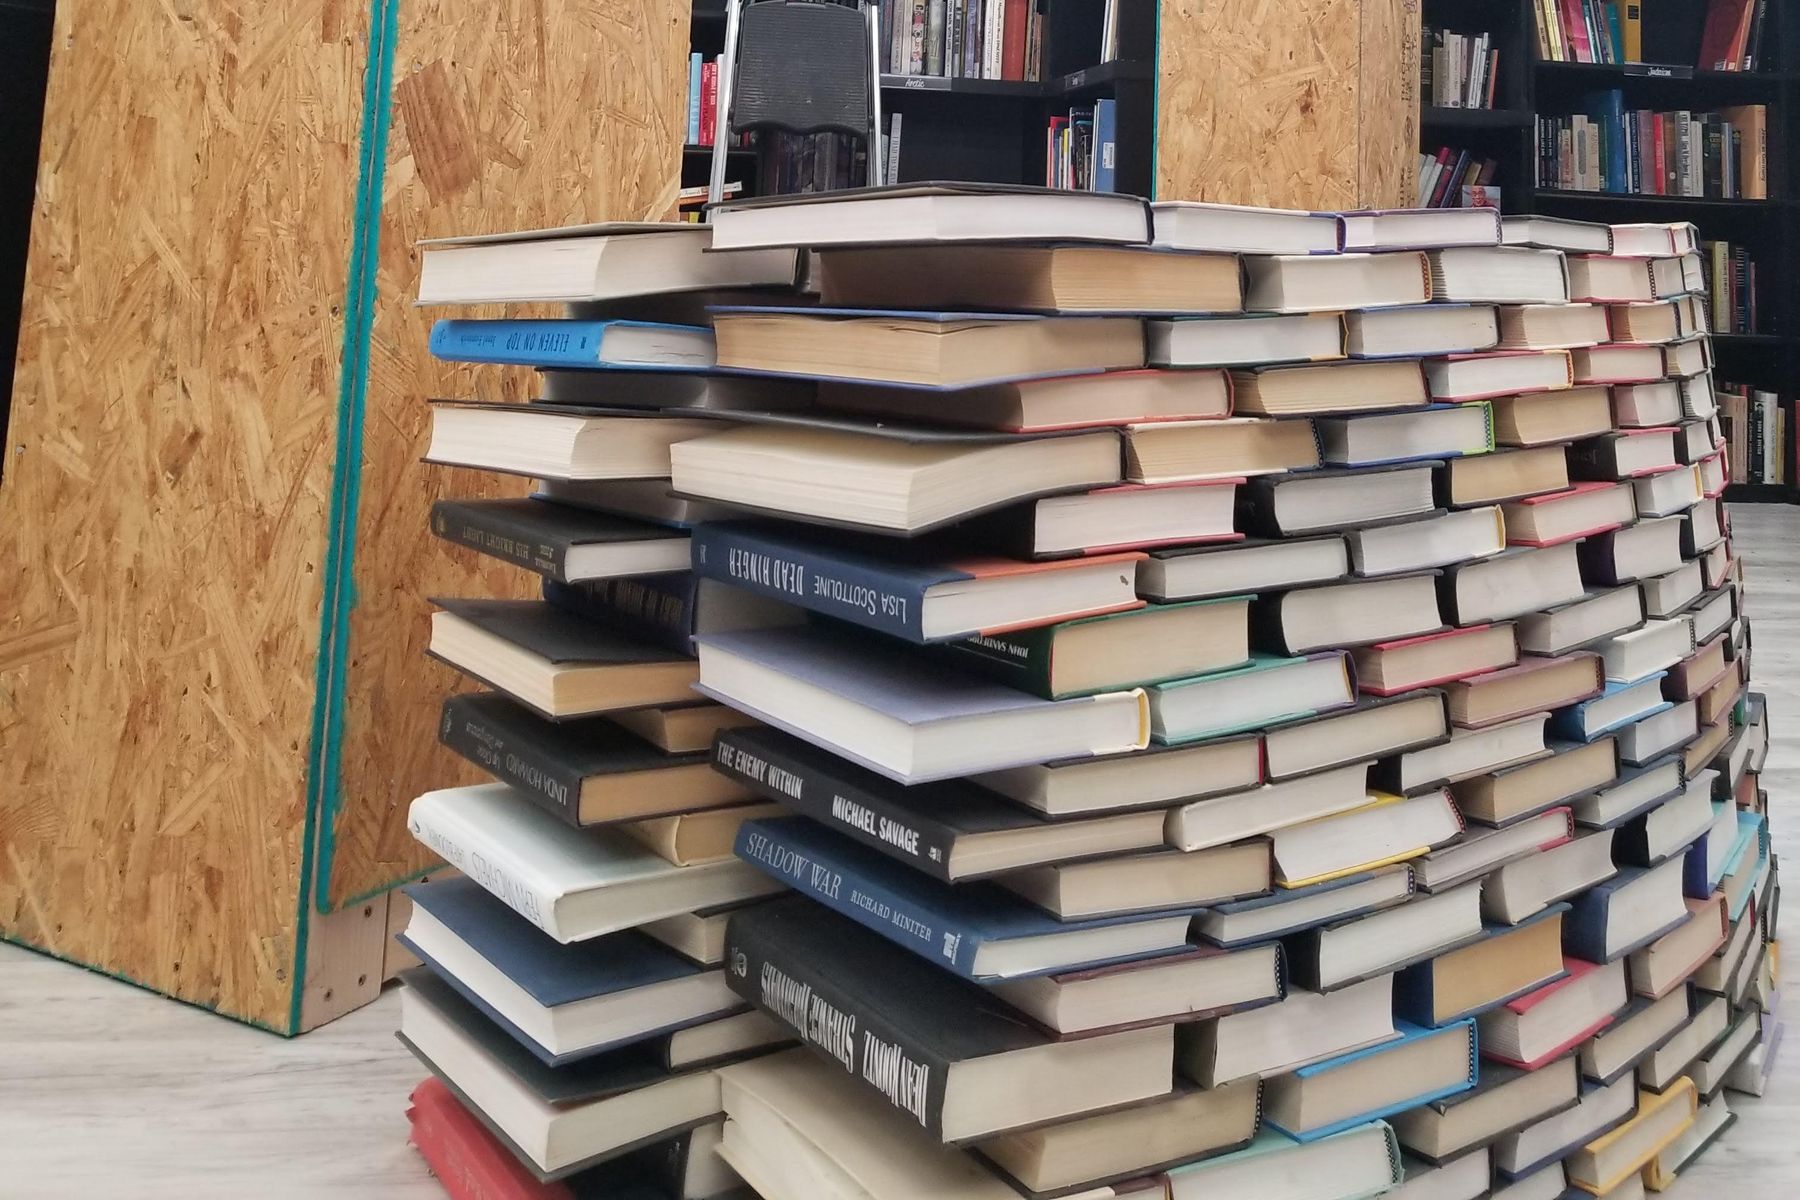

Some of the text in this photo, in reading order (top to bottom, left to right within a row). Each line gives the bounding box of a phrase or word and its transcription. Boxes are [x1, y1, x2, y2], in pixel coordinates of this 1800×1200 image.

[904, 78, 926, 89] Arctic
[506, 332, 570, 353] ELEVEN ON TOP
[463, 527, 484, 545] LIGHT
[486, 533, 514, 555] BRIGHT
[515, 542, 529, 560] HIS
[729, 547, 804, 596] DEAD RINGER
[814, 575, 907, 624] LISA SCOTTOLINE
[1007, 645, 1029, 659] JOHN
[506, 753, 568, 806] LINDA HOWARD
[717, 741, 803, 801] THE ENEMY WITHIN
[832, 795, 920, 857] MICHAEL SAVAGE
[745, 833, 842, 900] SHADOW WAR
[850, 889, 932, 942] RICHARD MINITER
[808, 994, 857, 1074] STRANGE
[862, 1029, 931, 1128] DEAN KOONTZ
